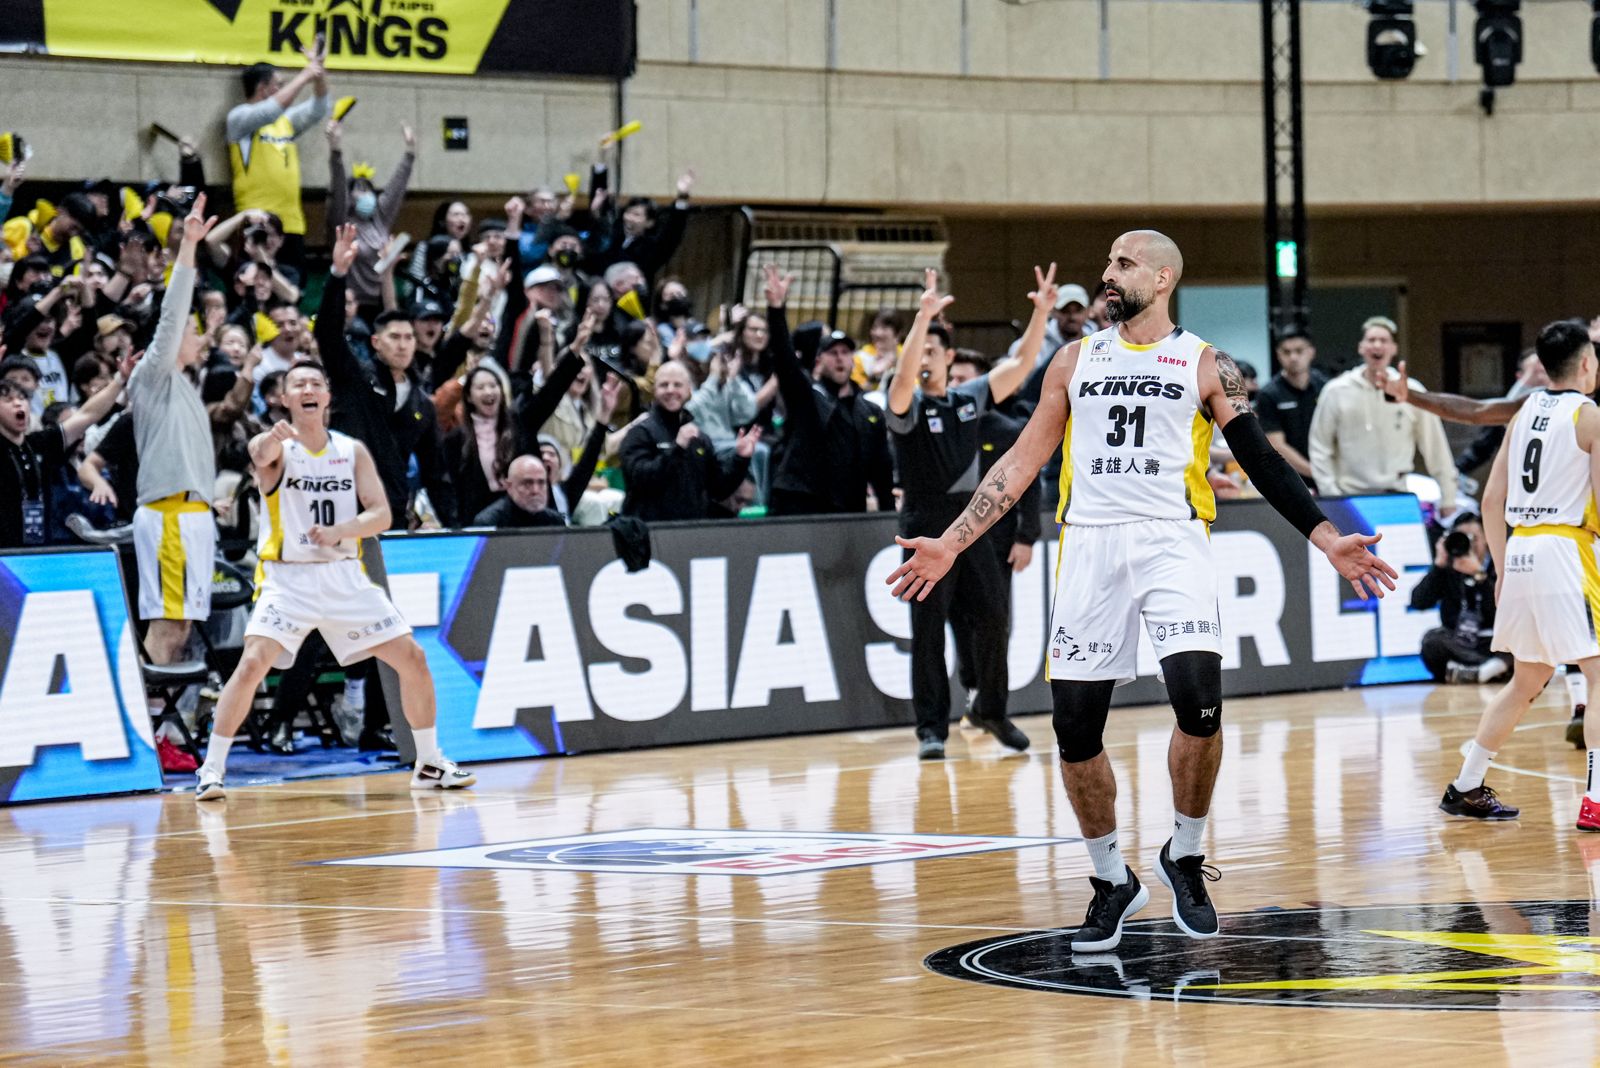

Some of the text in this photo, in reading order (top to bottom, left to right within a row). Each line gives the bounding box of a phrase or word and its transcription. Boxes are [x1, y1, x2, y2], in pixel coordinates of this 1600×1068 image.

[389, 1, 434, 12] TAIPEI
[270, 11, 449, 60] KINGS
[1157, 355, 1188, 367] SAMPO
[1079, 381, 1185, 400] KINGS
[1106, 405, 1147, 448] 31
[1090, 457, 1160, 476] 遠雄人壽
[1521, 438, 1543, 494] 9
[286, 477, 352, 492] KINGS
[309, 499, 335, 527] 10
[971, 494, 992, 518] 13
[472, 552, 841, 730] ASIA
[1088, 642, 1112, 654] 建設
[688, 841, 995, 870] EASL
